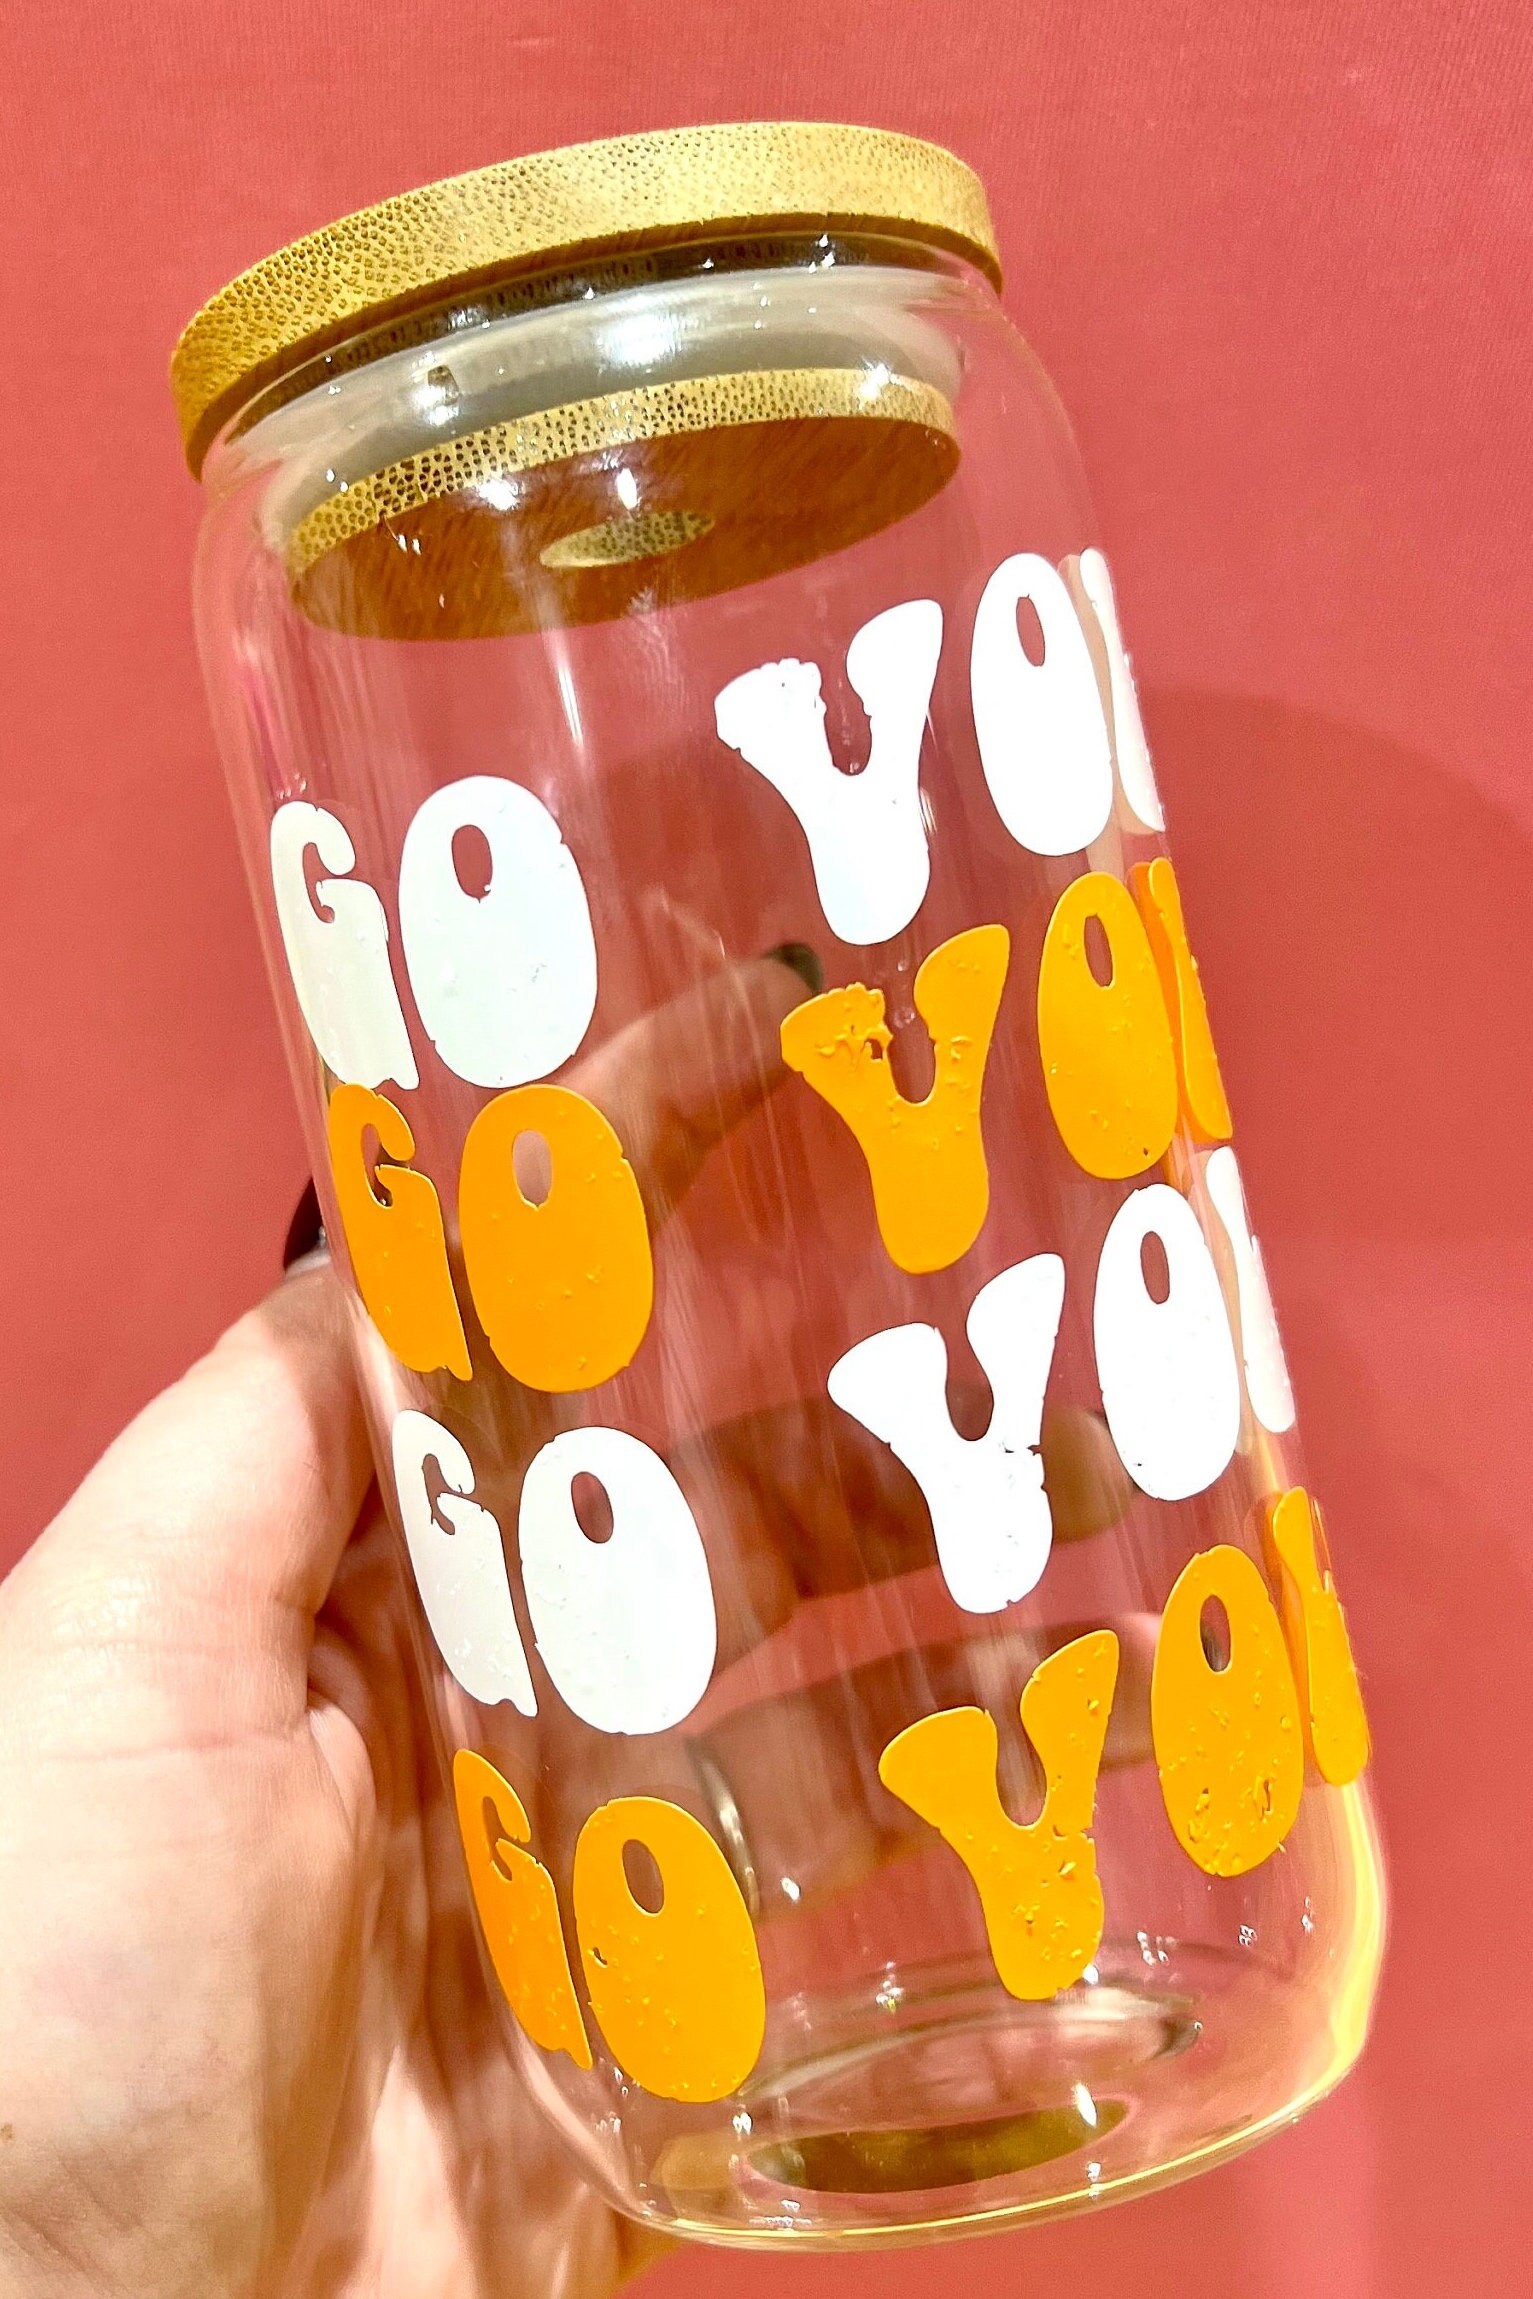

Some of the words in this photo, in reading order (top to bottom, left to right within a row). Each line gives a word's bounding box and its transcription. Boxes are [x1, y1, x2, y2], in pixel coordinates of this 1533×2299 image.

[271, 775, 598, 1090] GO
[329, 1083, 654, 1393] GO
[392, 1409, 718, 1736] GO
[454, 1749, 766, 2103] GO
